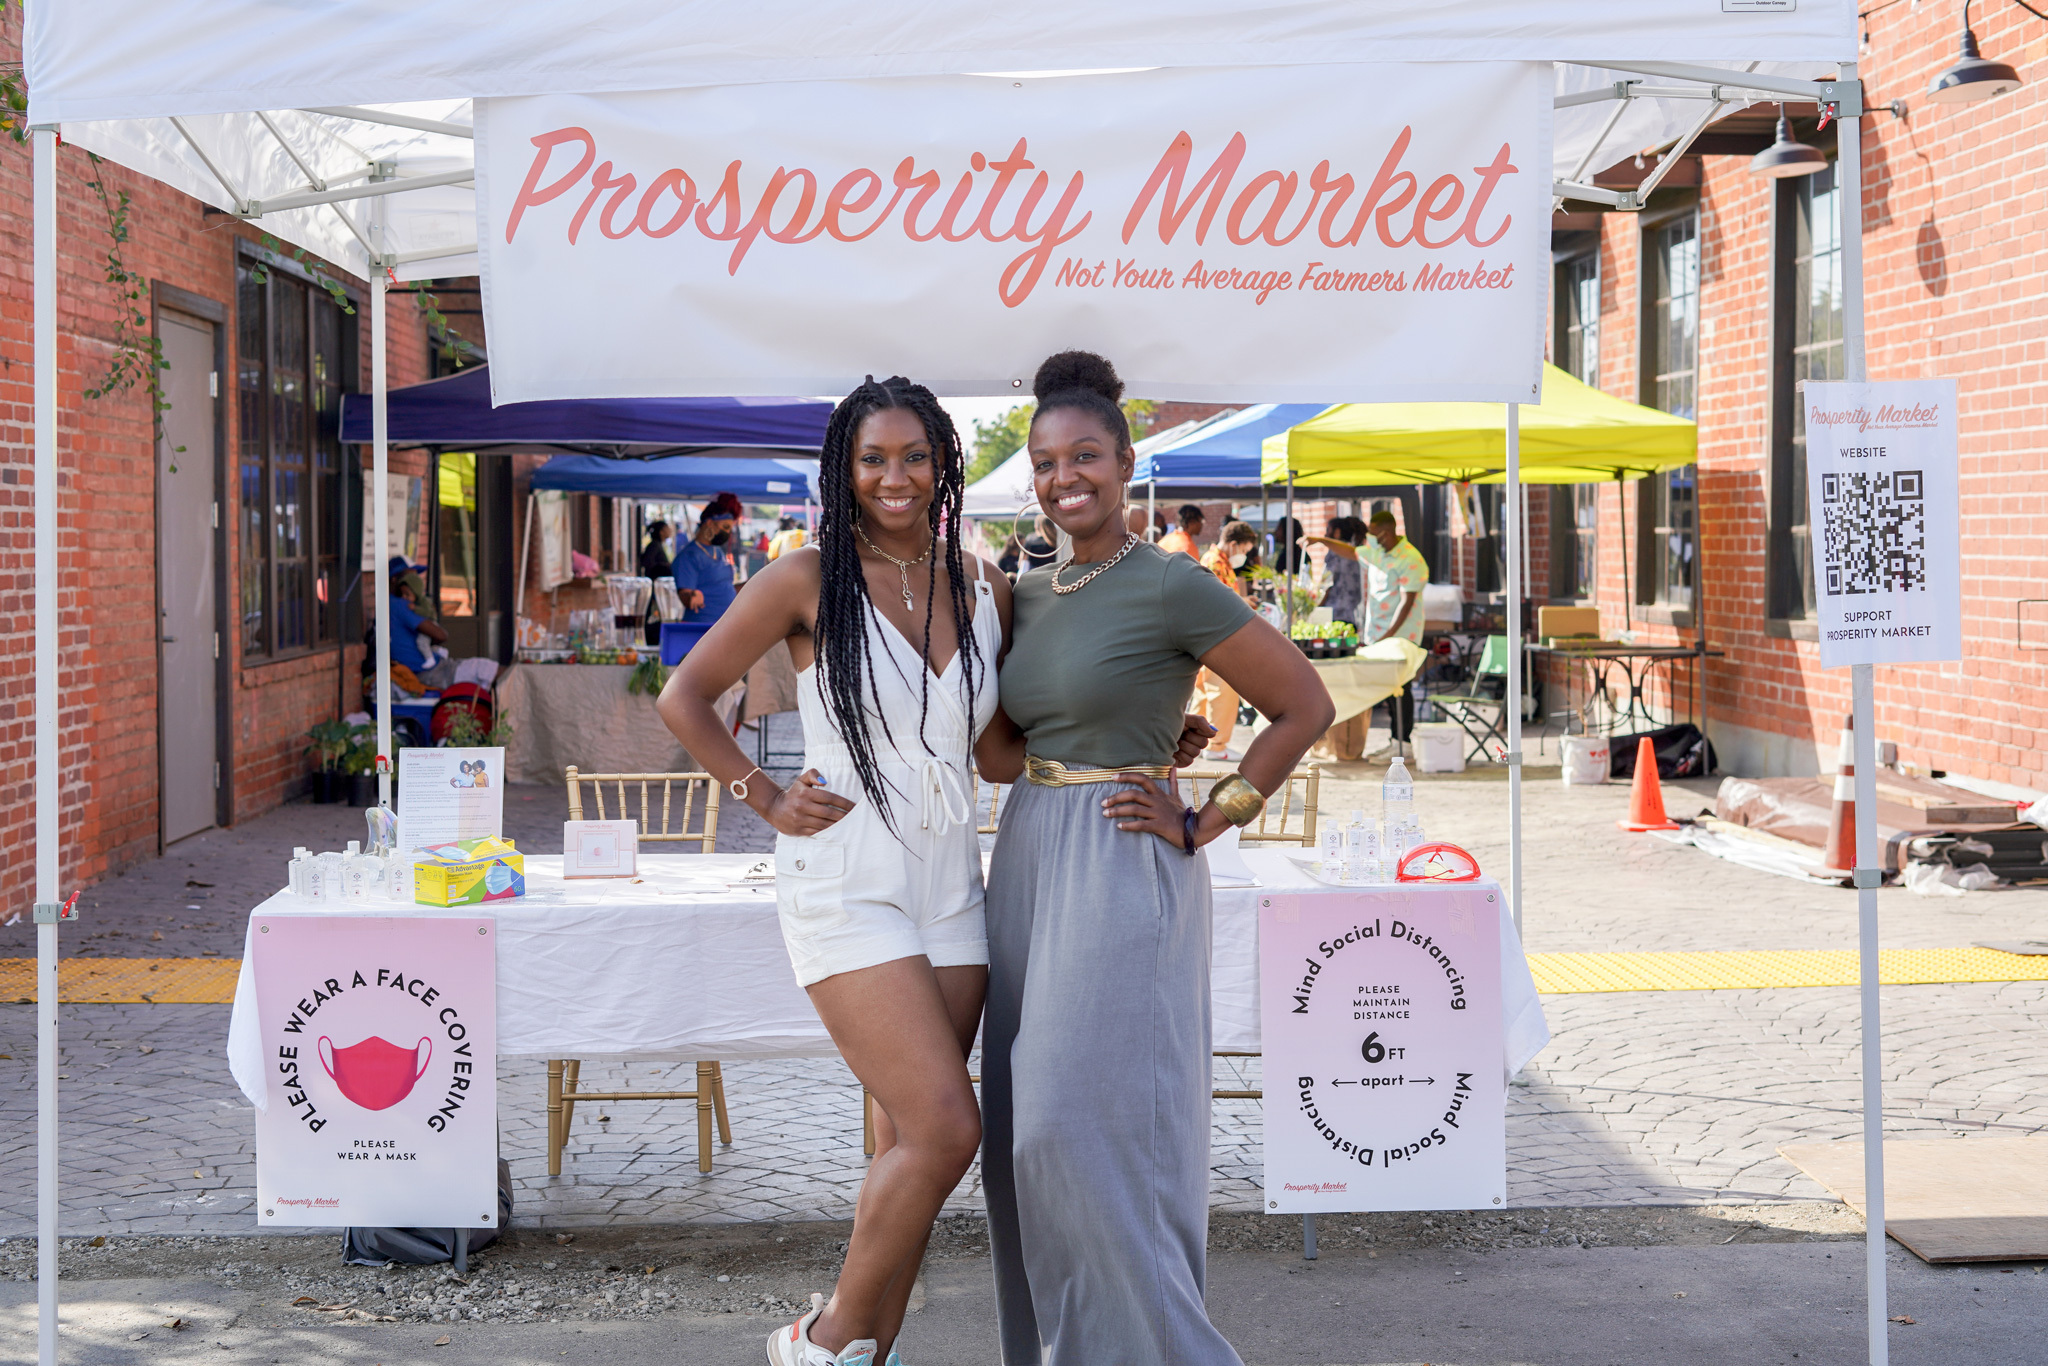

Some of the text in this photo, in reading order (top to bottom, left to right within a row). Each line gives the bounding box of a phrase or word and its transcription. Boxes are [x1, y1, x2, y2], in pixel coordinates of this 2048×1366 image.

[506, 126, 1519, 308] Prosperity Market
[1056, 257, 1514, 306] Not Your Average Farmers Market
[1810, 402, 1939, 433] Prosperity Market
[1840, 446, 1887, 458] WEBSITE
[1844, 610, 1892, 623] SUPPORT
[1827, 625, 1931, 641] PROSPERITY MARKET
[1291, 918, 1466, 1014] Mind Social Distancing
[1358, 985, 1400, 994] PLEASE
[1353, 998, 1410, 1007] MAINTAIN
[1354, 1010, 1410, 1020] DISTANCE
[279, 968, 472, 1133] PLEASE WEAR A FACE COVERING
[1361, 1031, 1406, 1064] 6 FT
[1361, 1075, 1405, 1089] apart
[1298, 1072, 1474, 1168] Mind Social Distancing
[353, 1139, 396, 1148] PLEASE
[337, 1152, 417, 1161] WEAR A MASK
[1284, 1181, 1347, 1194] Prosperity Market
[276, 1196, 340, 1209] Prosperity Market
